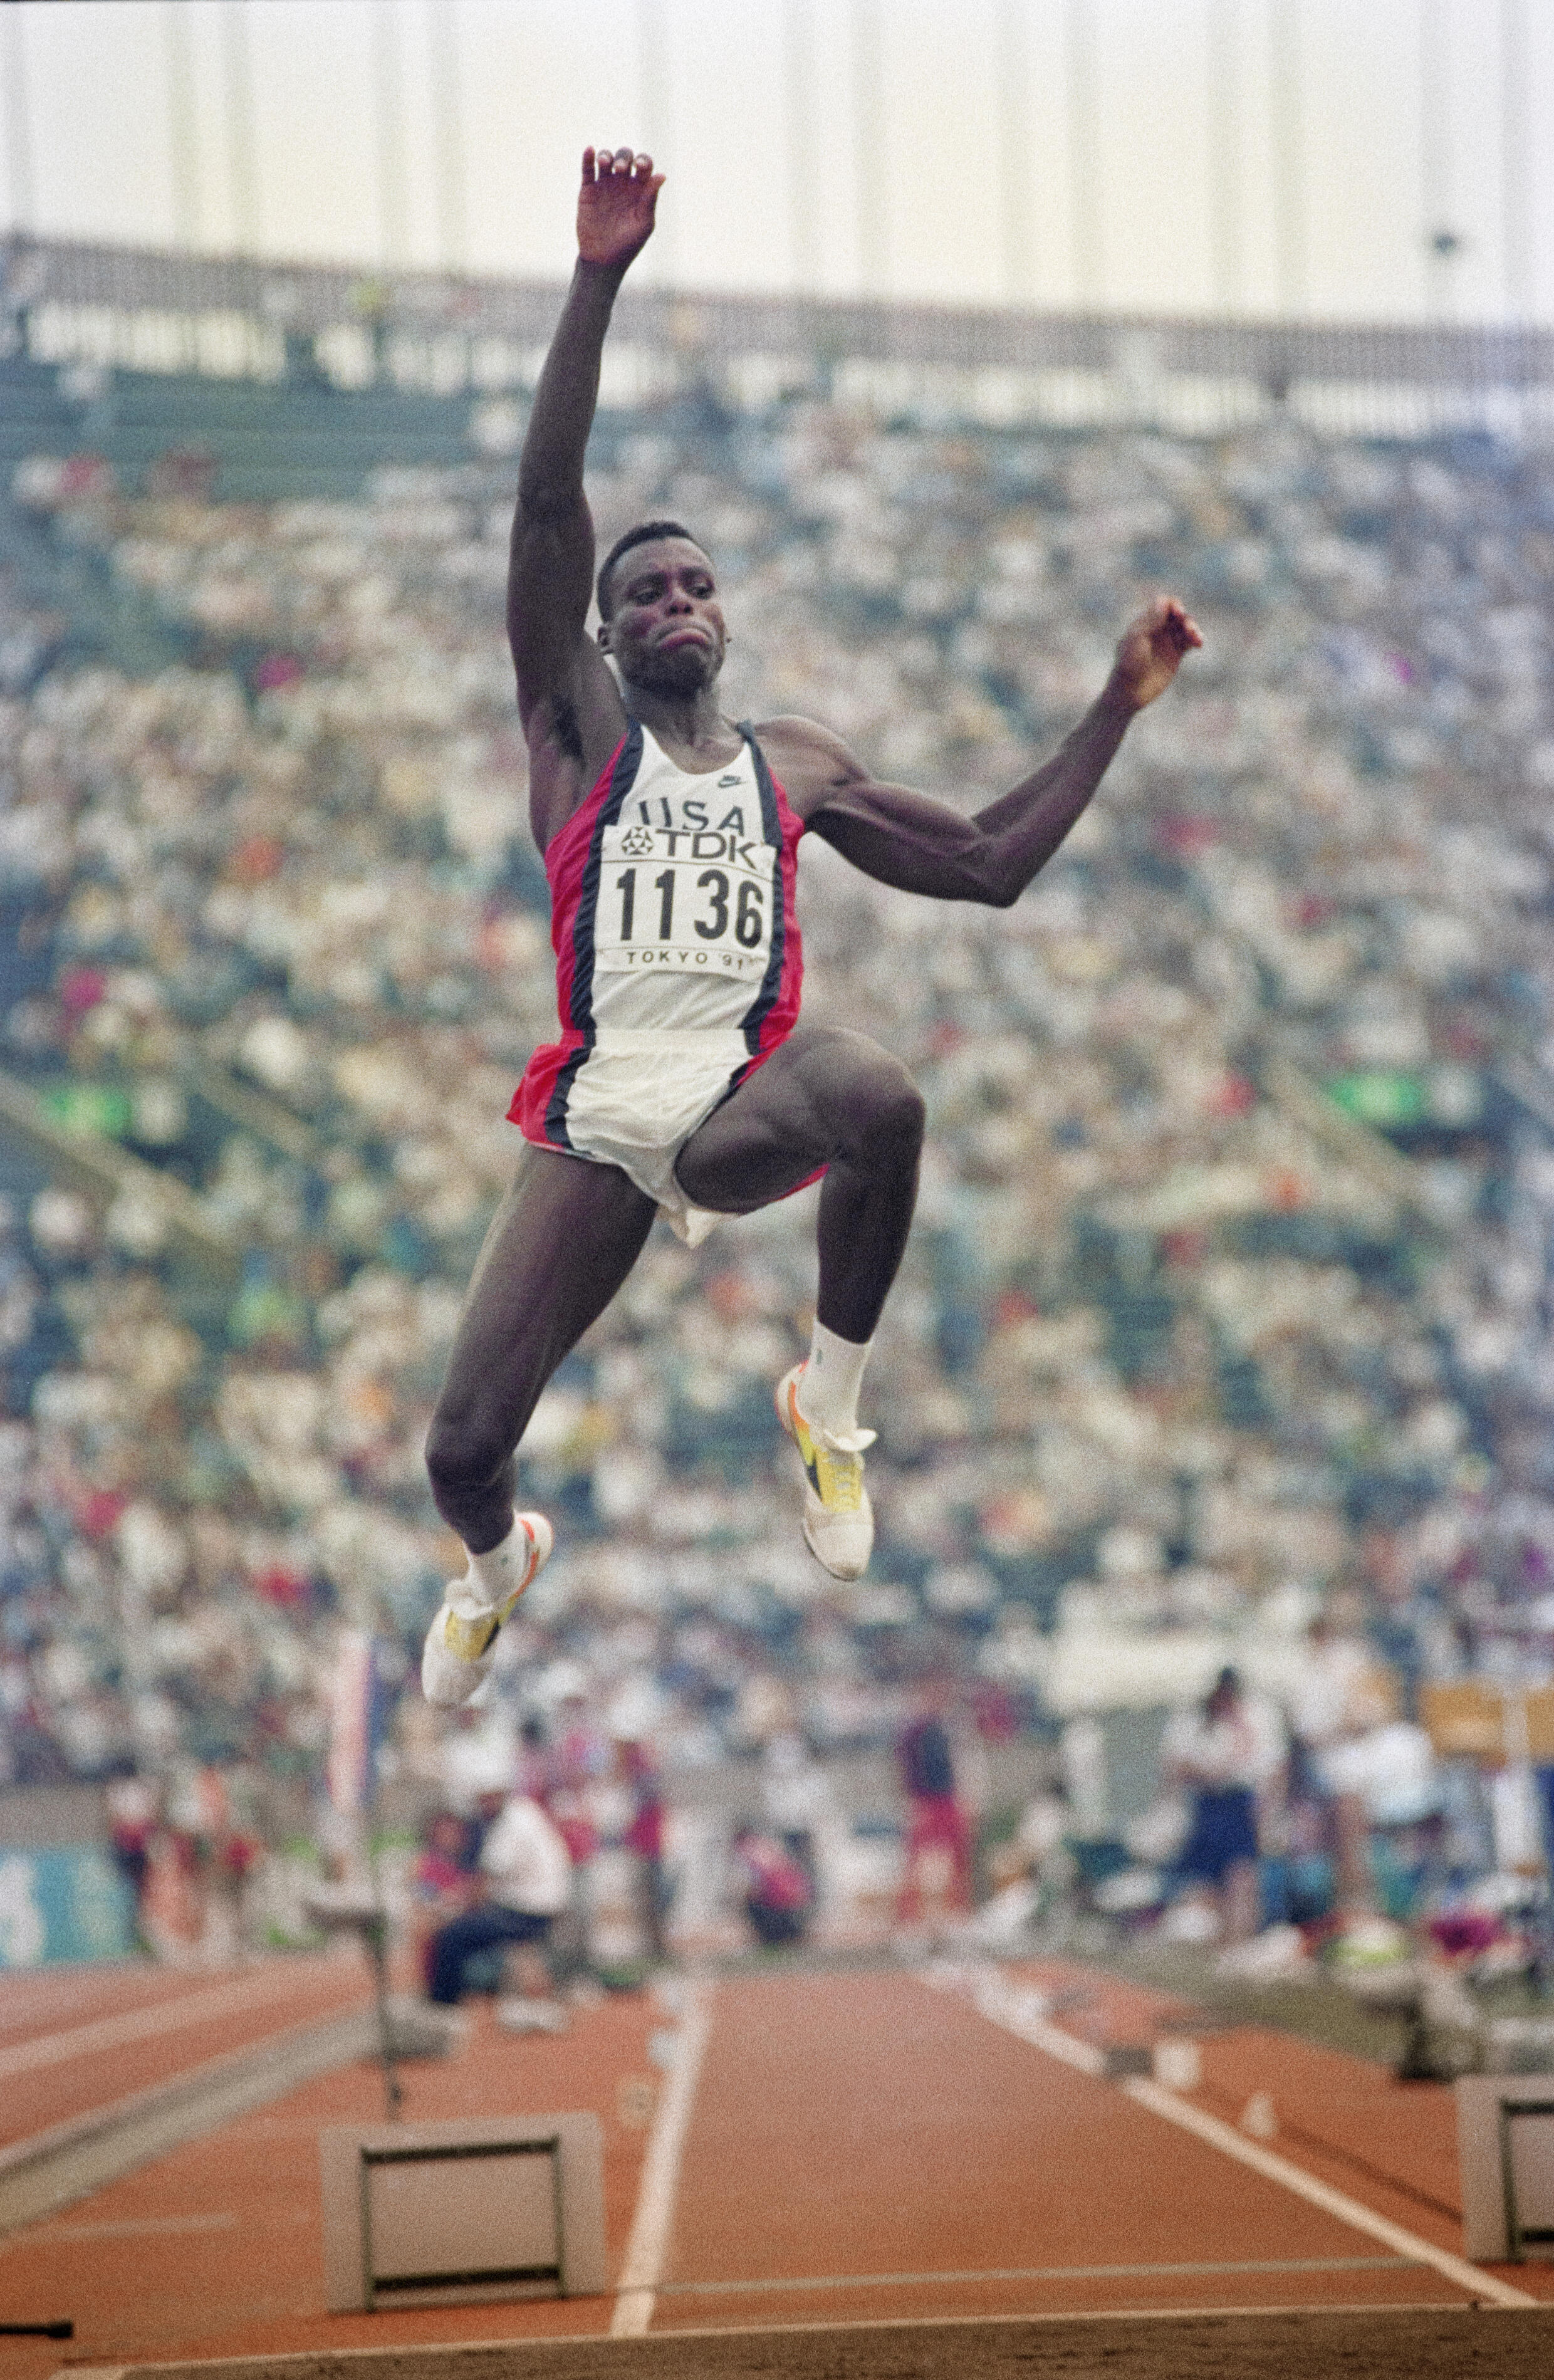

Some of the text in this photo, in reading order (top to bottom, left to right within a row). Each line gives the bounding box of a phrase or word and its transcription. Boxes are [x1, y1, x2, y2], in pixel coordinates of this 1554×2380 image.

[655, 828, 756, 870] TDK
[616, 869, 764, 948] 1136
[627, 951, 707, 964] TOKYO
